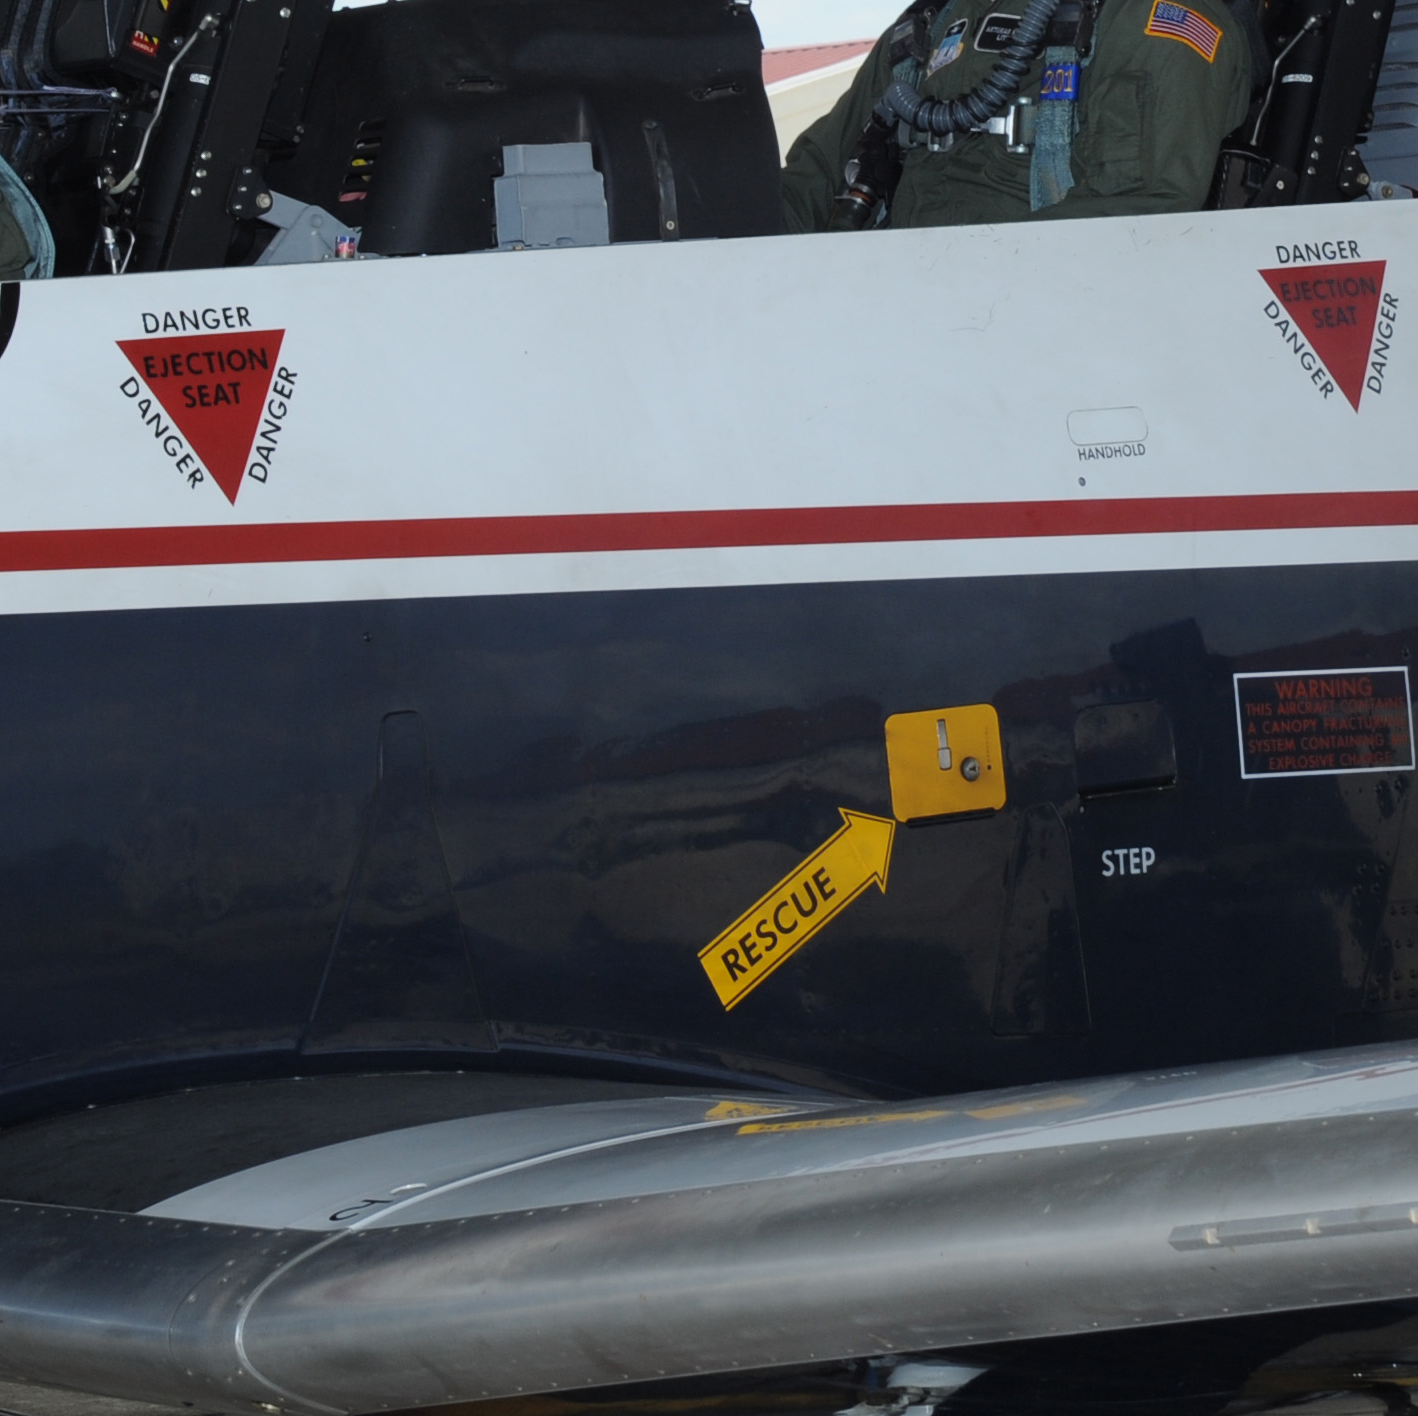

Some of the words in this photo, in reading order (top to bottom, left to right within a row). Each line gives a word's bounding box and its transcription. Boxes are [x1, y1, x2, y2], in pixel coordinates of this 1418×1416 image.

[1040, 69, 1074, 94] 201
[1275, 240, 1361, 264] DANGER
[1280, 276, 1377, 302] EJECTION
[141, 306, 252, 334] DANGER
[1312, 306, 1357, 328] SEAT
[1264, 300, 1335, 399] DANGER
[1366, 292, 1399, 394] DANGER
[143, 348, 269, 378] EJECTION
[182, 382, 241, 408] SEAT
[119, 376, 205, 489] DANGER
[248, 366, 298, 484] DANGER
[1077, 443, 1146, 461] HANDHOLD
[1275, 677, 1373, 699] WARNING
[1245, 703, 1272, 716] THIS
[1277, 700, 1335, 715] AIRCRAFT
[1248, 723, 1257, 734] A
[1263, 719, 1317, 733] CANOPY
[1248, 738, 1296, 753] SYSTEM
[1301, 734, 1384, 750] CONTAINING
[1269, 755, 1334, 770] EXPLOSIVE
[1340, 751, 1391, 767] CHARGE
[1101, 846, 1156, 877] STEP
[721, 866, 837, 982] RESCUE
